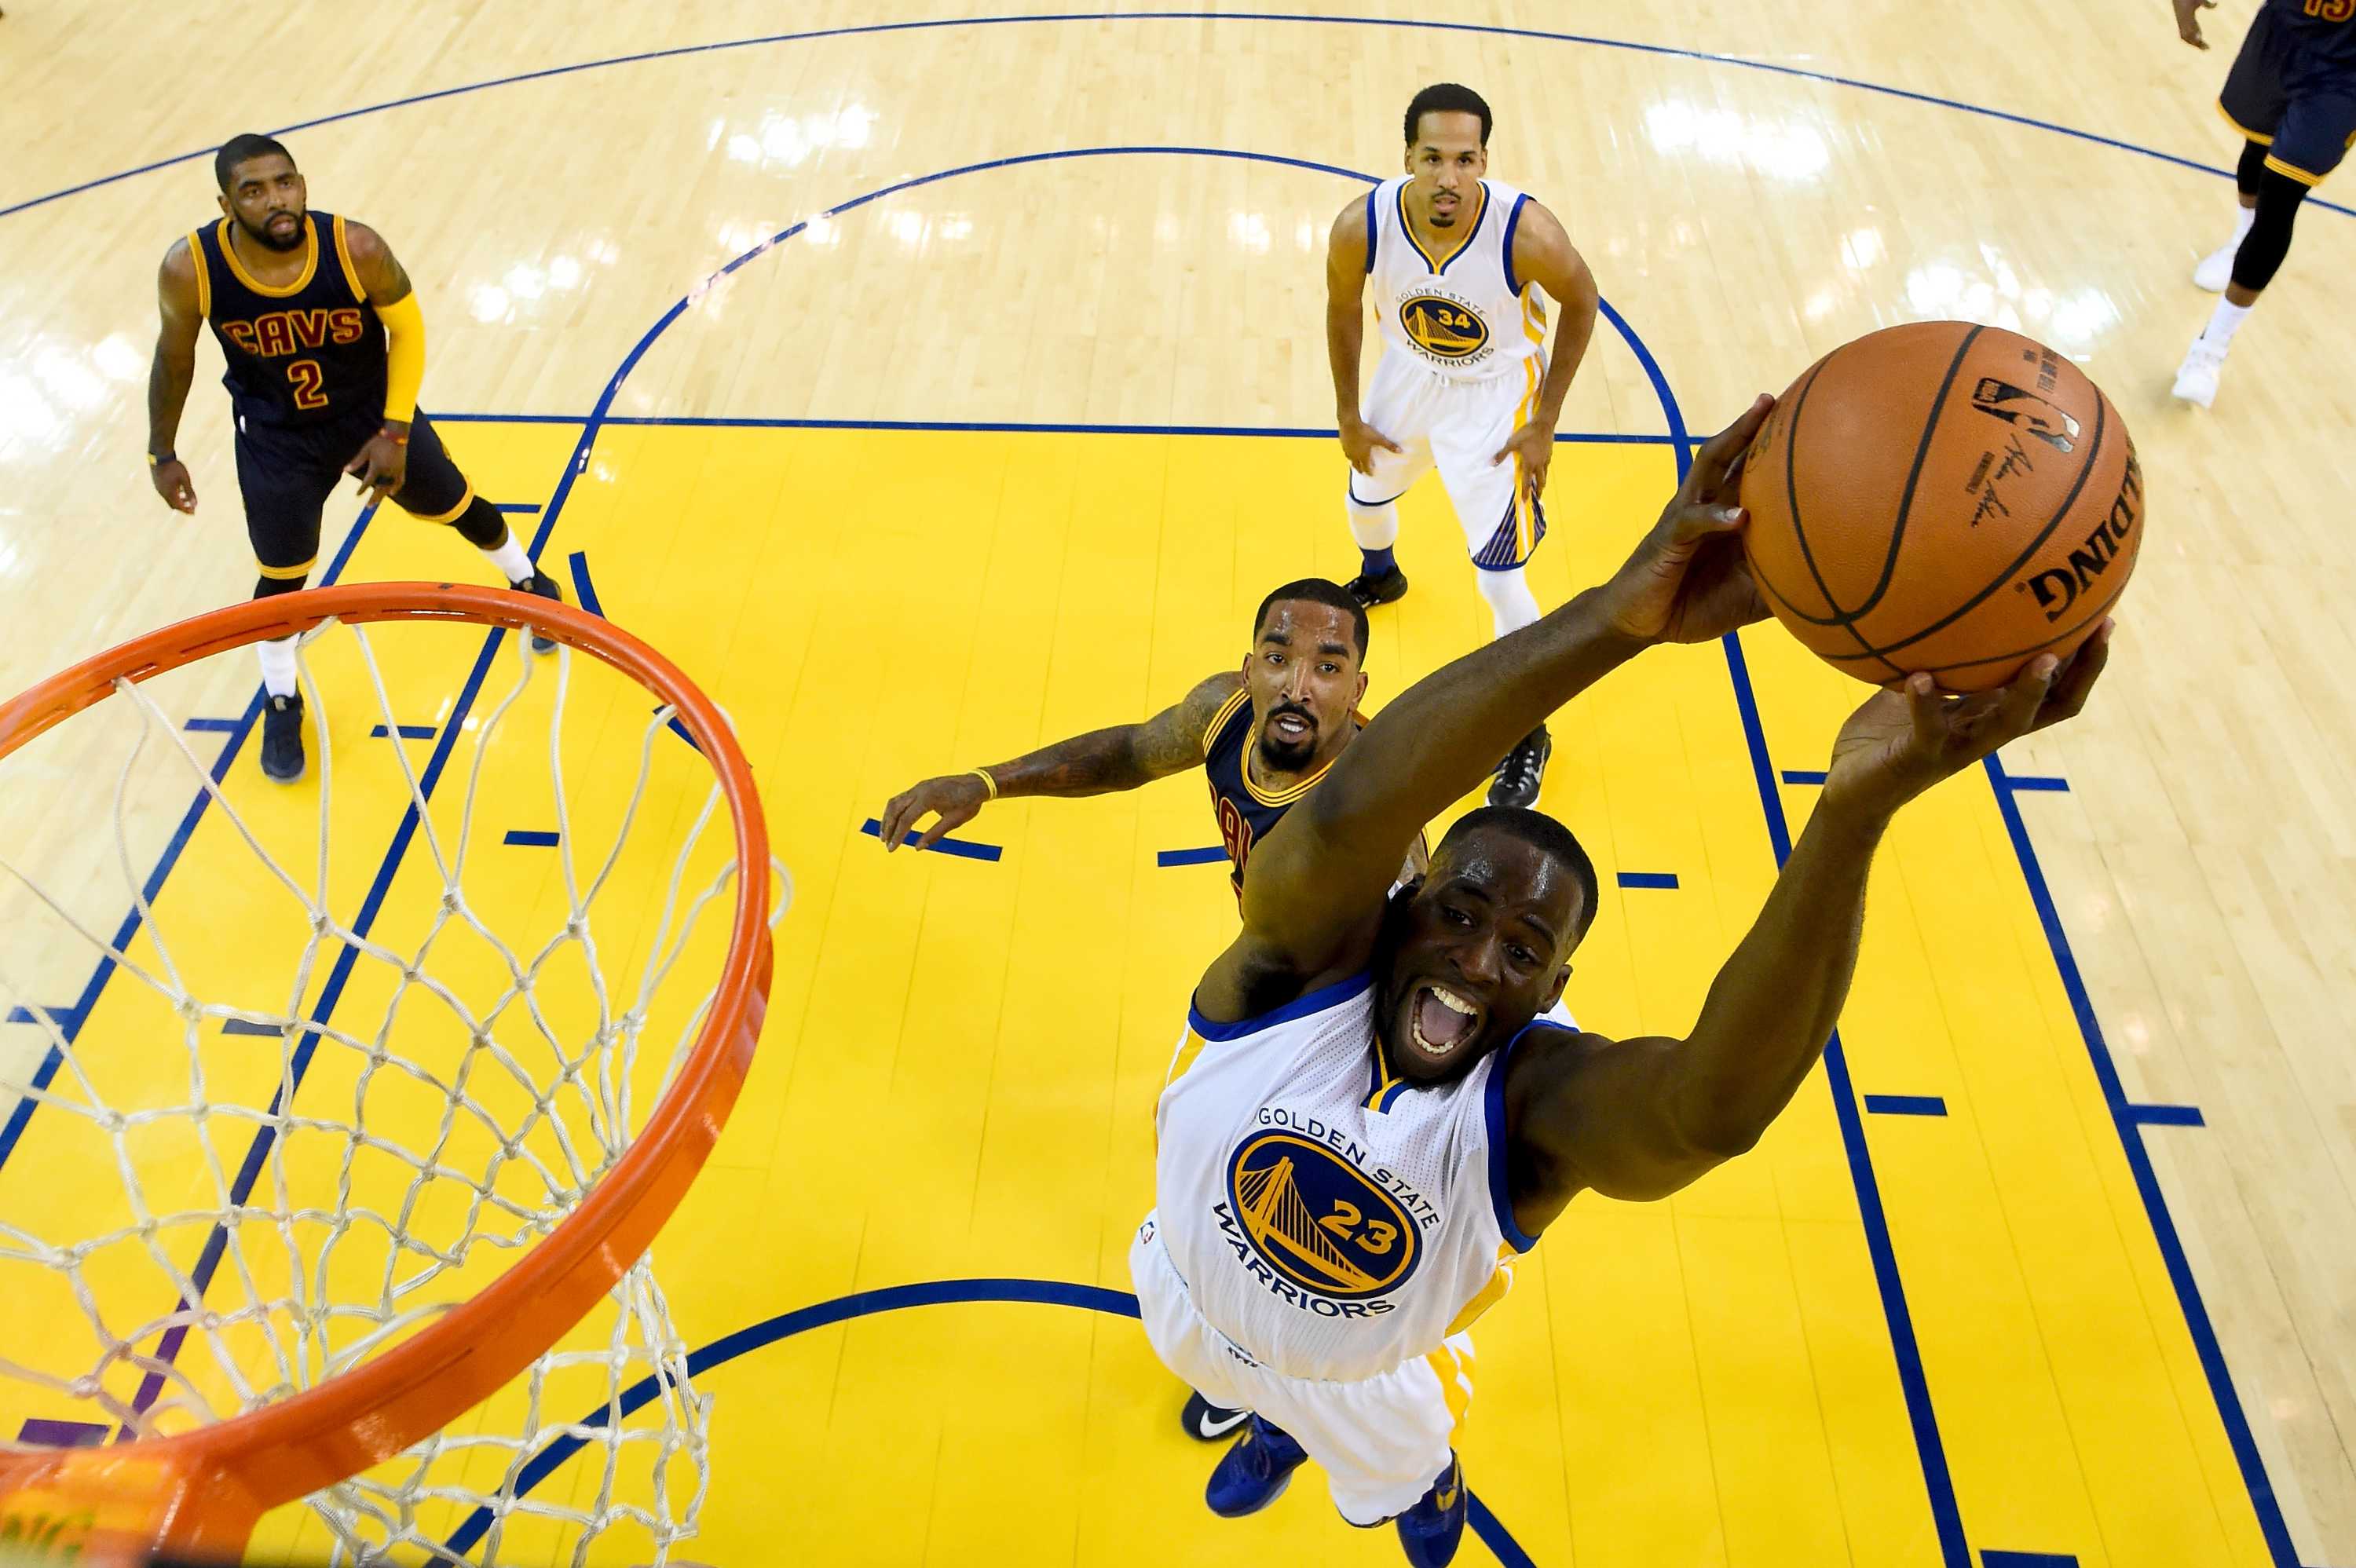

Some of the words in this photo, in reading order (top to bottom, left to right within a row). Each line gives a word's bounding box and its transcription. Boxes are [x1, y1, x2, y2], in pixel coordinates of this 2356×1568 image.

[1396, 288, 1443, 302] GOLDEN
[1449, 292, 1486, 316] STATE
[1437, 308, 1471, 329] 34
[221, 308, 363, 357] CAVS
[1407, 338, 1494, 367] WARRIORS
[287, 359, 329, 411] 2
[2028, 455, 2141, 624] LDING
[1258, 1107, 1366, 1165] GOLDEN
[1372, 1168, 1440, 1230] STATE
[1318, 1199, 1398, 1255] 23
[1213, 1201, 1396, 1319] WARRIORS
